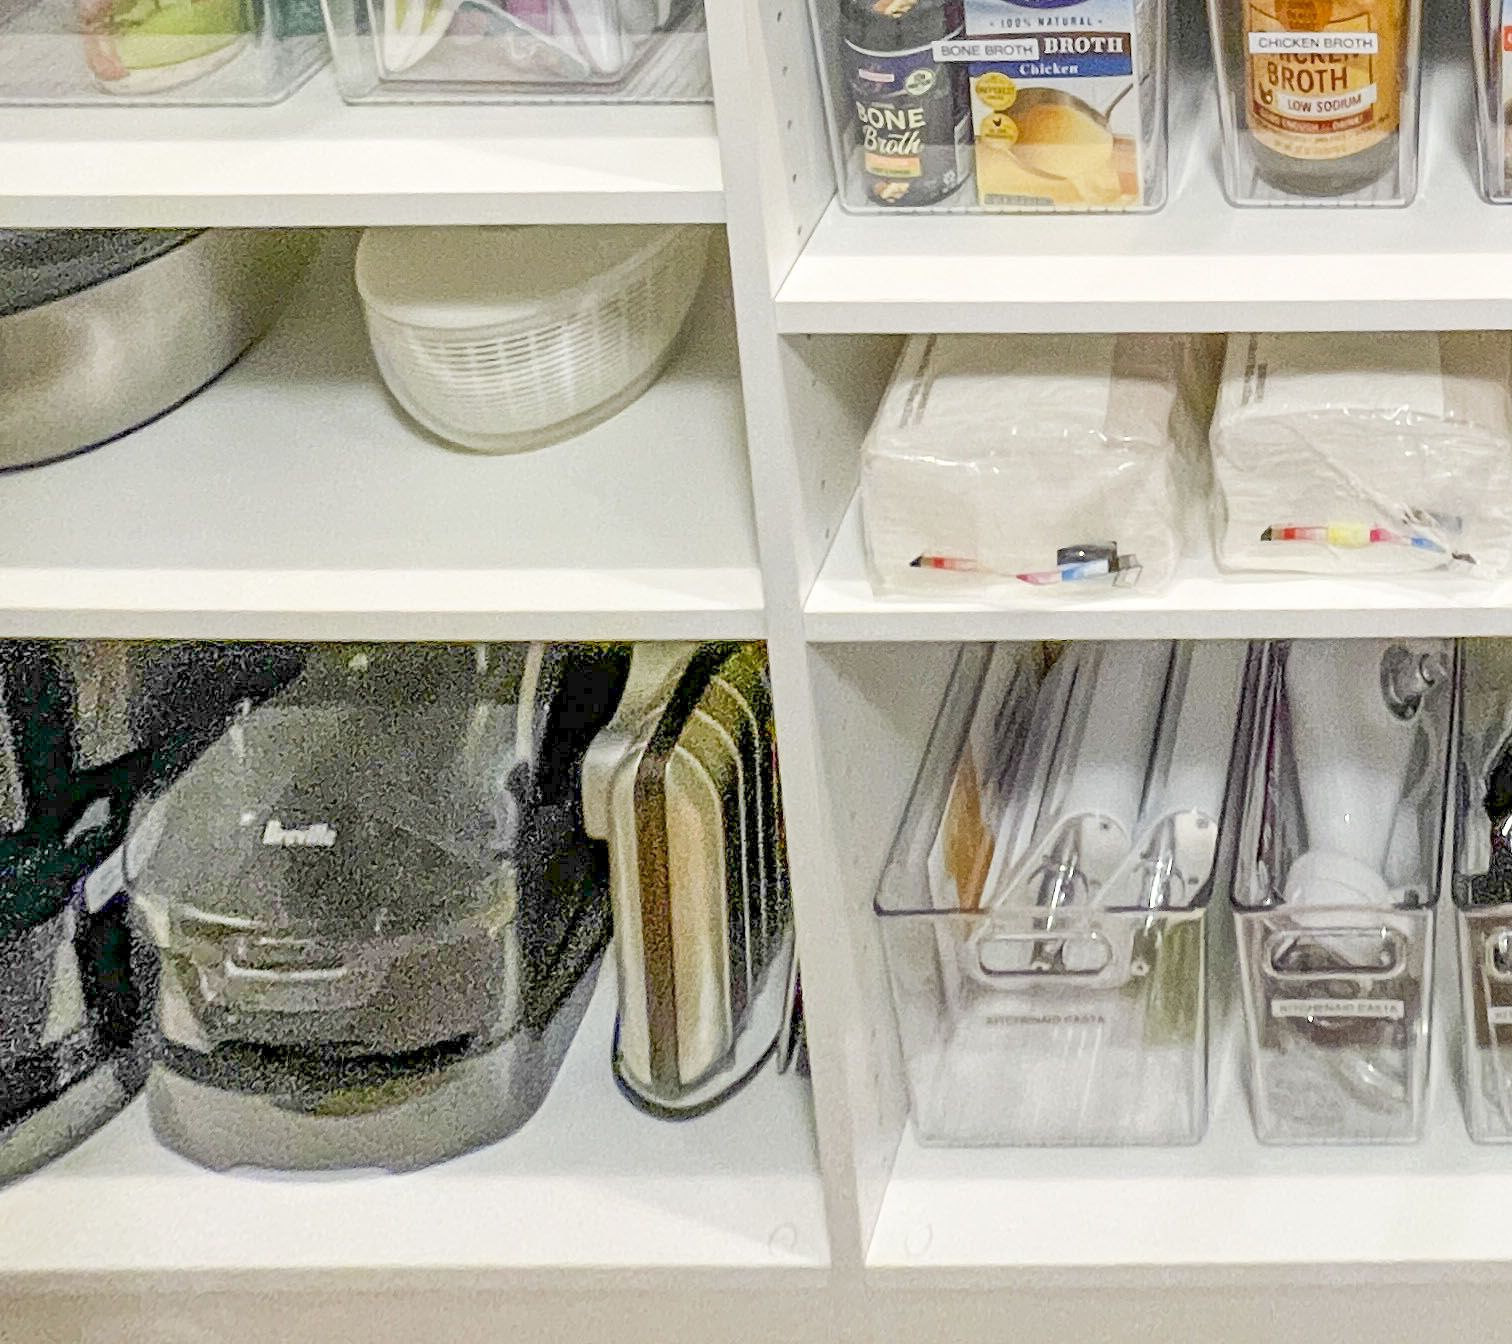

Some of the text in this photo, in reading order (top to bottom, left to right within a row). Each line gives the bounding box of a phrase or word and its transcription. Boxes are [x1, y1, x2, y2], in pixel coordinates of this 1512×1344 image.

[1000, 16, 1093, 27] 100% NATURAL
[940, 45, 1033, 57] BONE BROTH
[1043, 35, 1124, 54] BROTH
[1258, 37, 1373, 49] CHICKEN BROTH
[1018, 62, 1078, 75] Chicken
[1267, 61, 1348, 94] BROTH
[1287, 93, 1362, 113] LOW SODIUM
[856, 105, 927, 130] BONE
[862, 130, 922, 155] Broth
